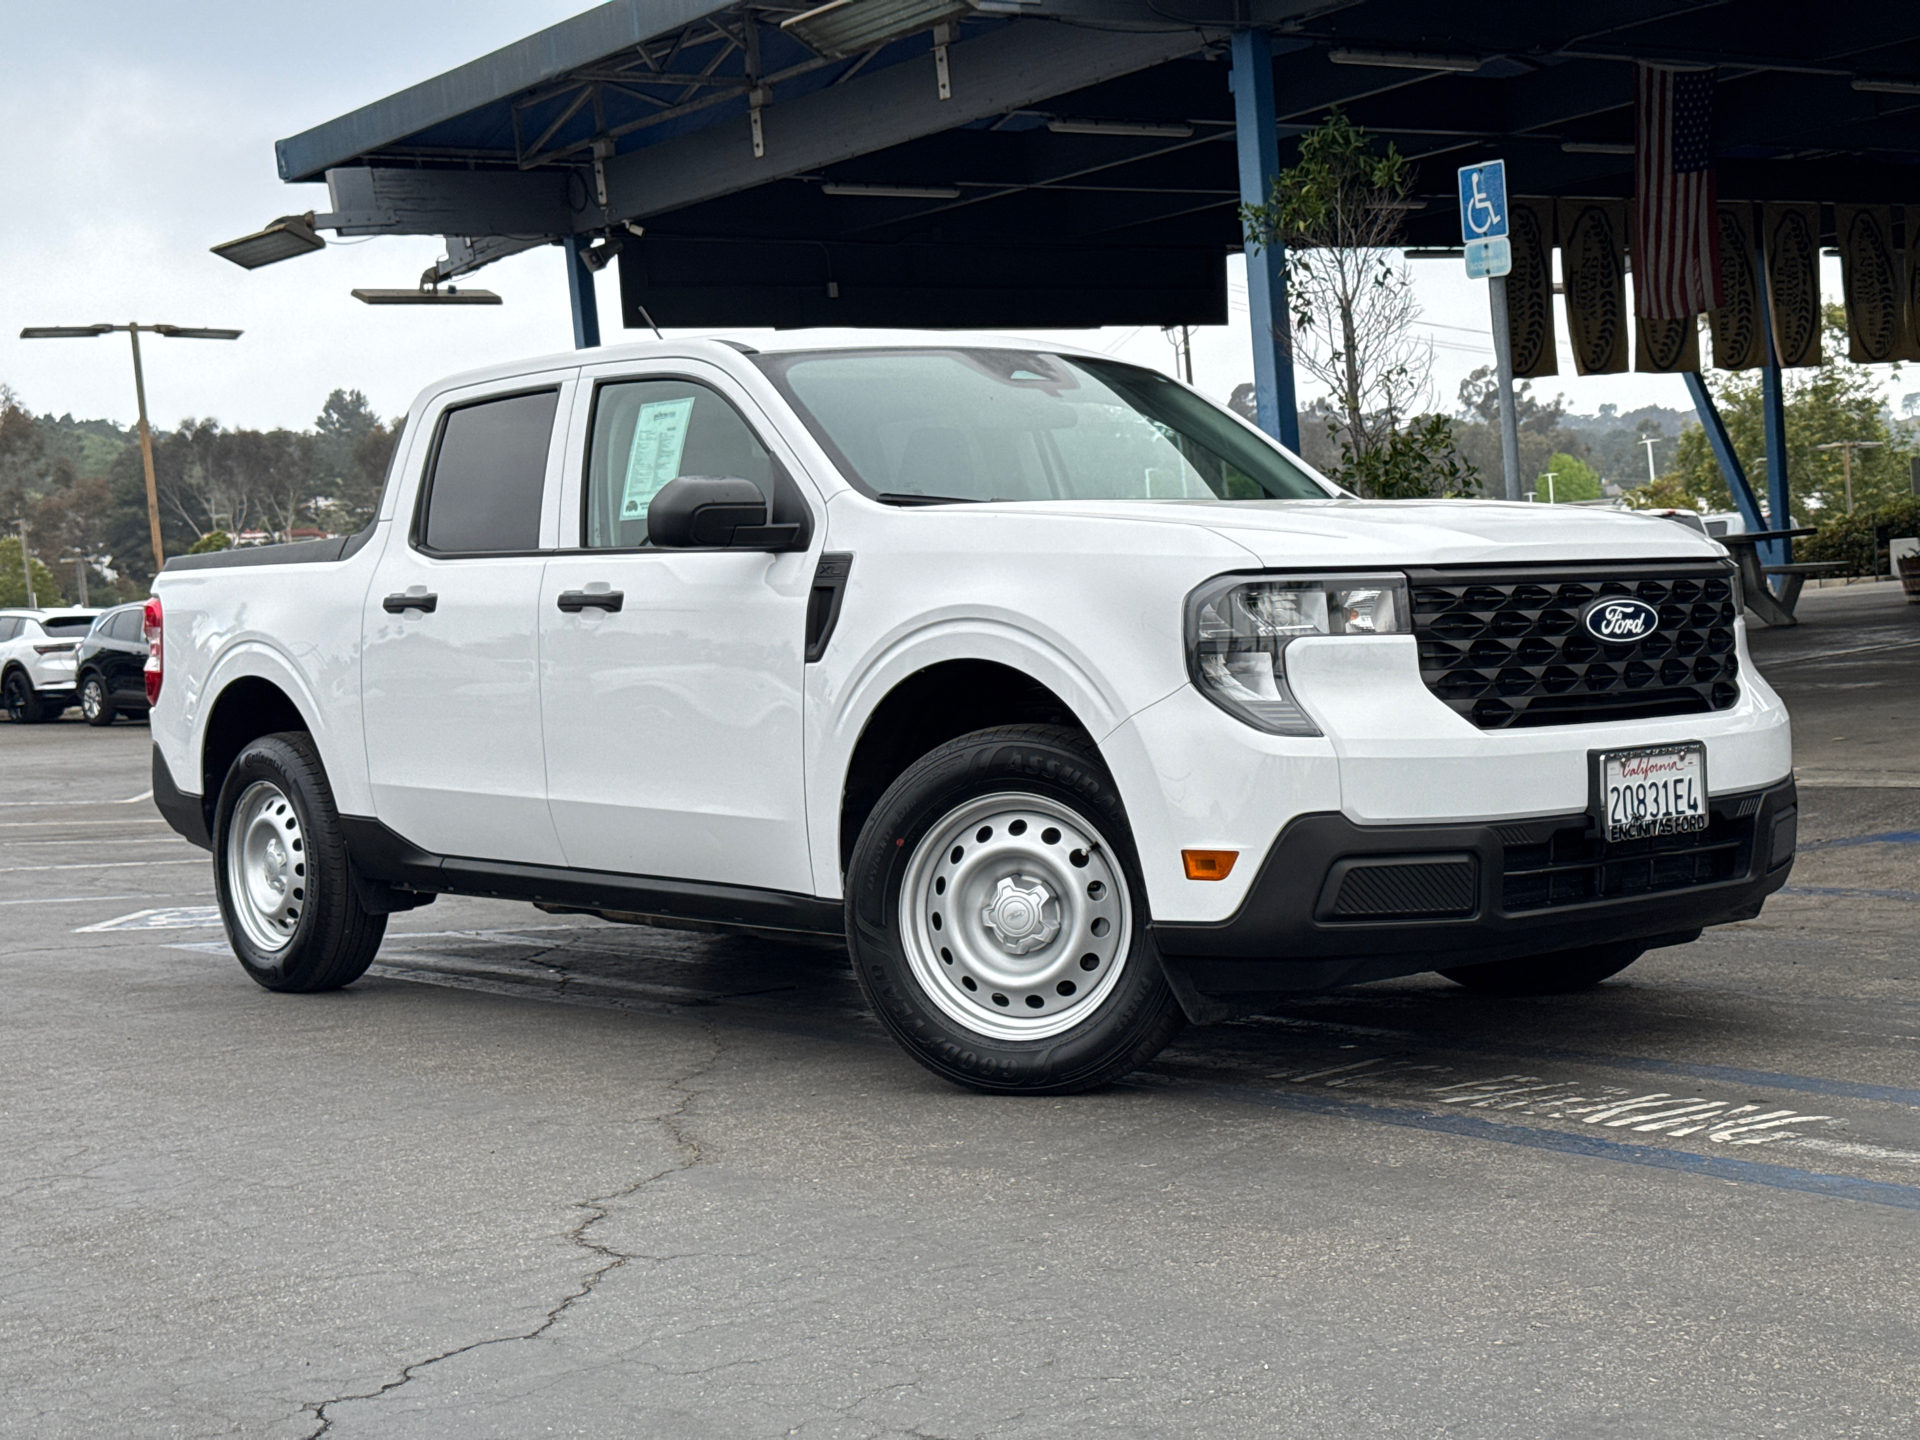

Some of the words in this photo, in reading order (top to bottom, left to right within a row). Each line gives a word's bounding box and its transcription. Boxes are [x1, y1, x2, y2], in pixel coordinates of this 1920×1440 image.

[1517, 256, 1527, 320] AWARD
[1588, 256, 1599, 320] AWARD
[1729, 256, 1737, 317] AWARD
[1790, 256, 1799, 315] AWARD
[1601, 605, 1646, 635] Ford
[1622, 756, 1684, 781] California
[1609, 777, 1699, 824] 20831E4
[1610, 818, 1674, 841] ENCINITAS
[1674, 814, 1705, 832] FORD
[870, 964, 1019, 1078] GOODYEAR
